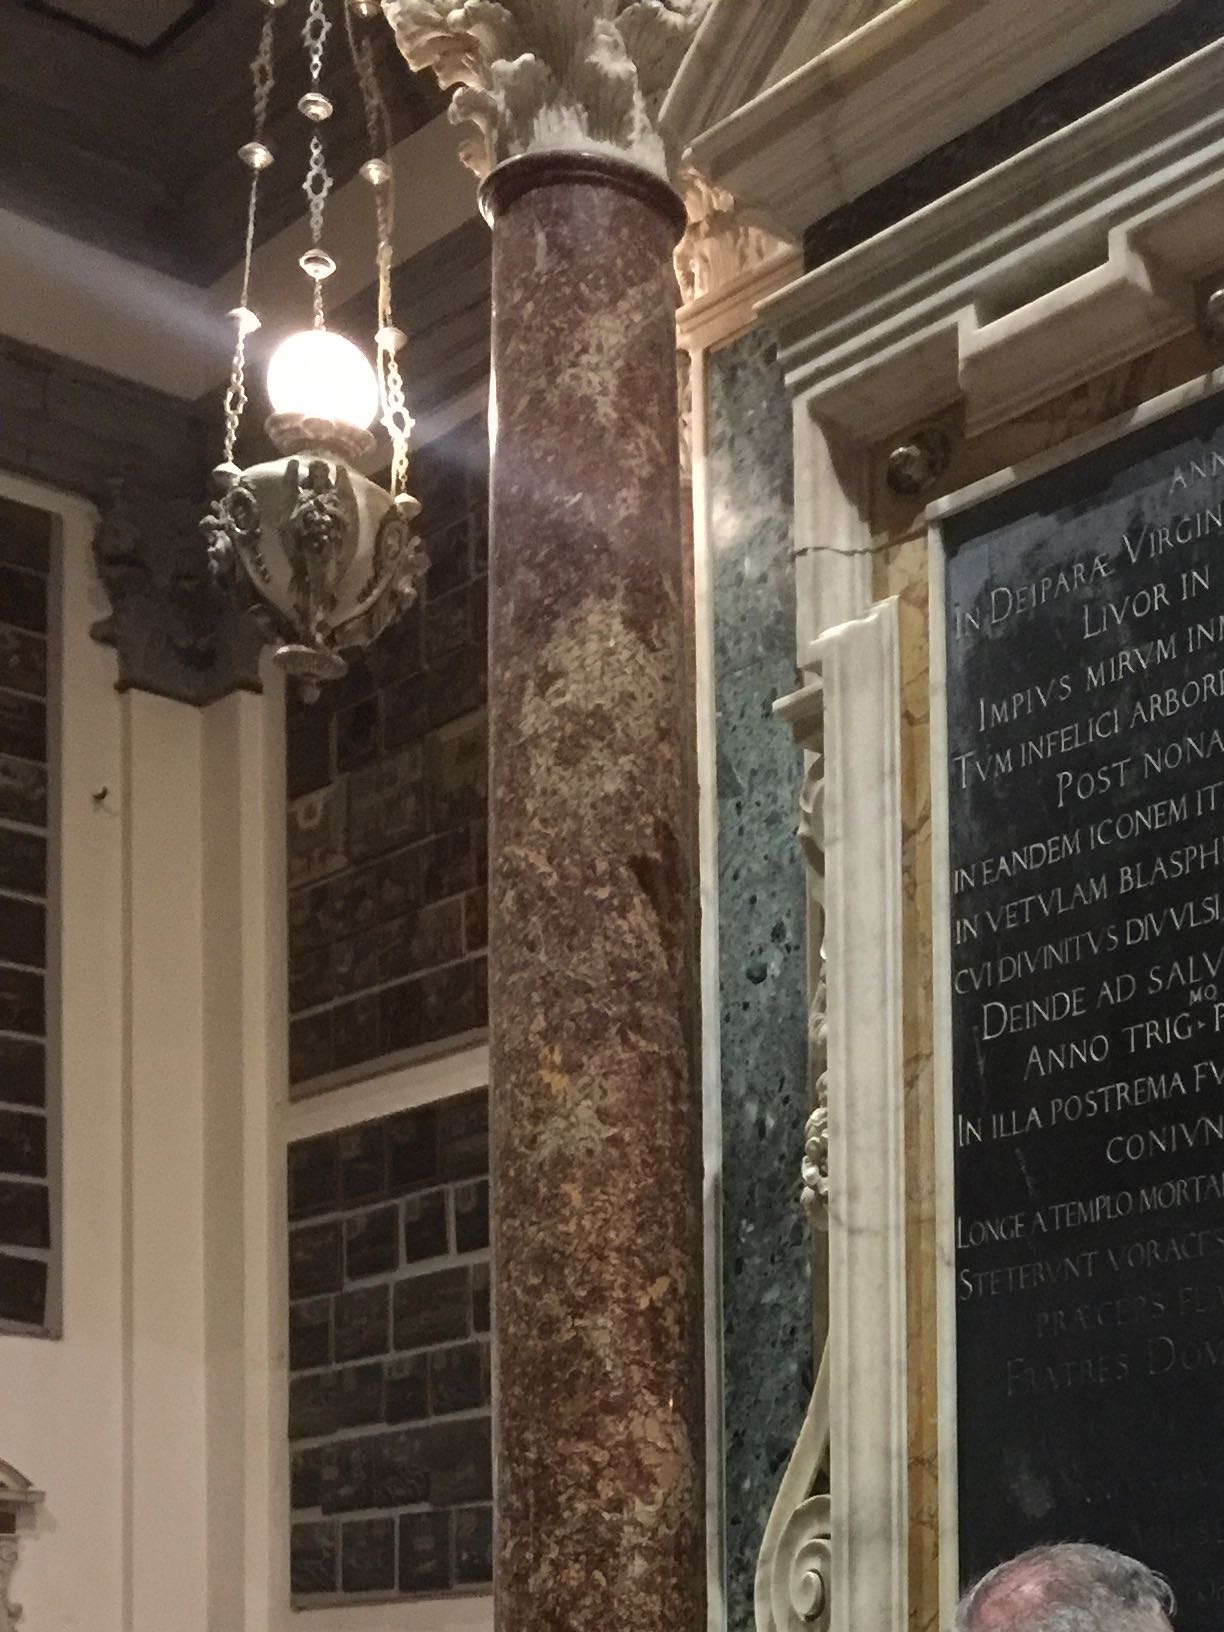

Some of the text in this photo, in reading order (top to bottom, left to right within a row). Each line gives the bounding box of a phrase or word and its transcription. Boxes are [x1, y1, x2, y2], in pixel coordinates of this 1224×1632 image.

[954, 604, 980, 640] IN
[1082, 582, 1171, 640] LIVOR
[1181, 564, 1210, 600] IN
[978, 674, 1072, 732] IMPIVS
[1086, 633, 1177, 692] MIRVM
[953, 748, 1014, 790] TVM
[1020, 708, 1120, 768] INFELICI
[1056, 757, 1132, 808] POST
[953, 863, 976, 894] IN
[982, 828, 1081, 887] EANDEM
[1089, 793, 1189, 850] ICONEM
[955, 918, 978, 945] IN
[985, 873, 1108, 933] VETVLAM
[954, 961, 993, 995] CVI
[999, 924, 1119, 985] DIVINITVS
[982, 987, 1087, 1041] DEINDE
[1097, 973, 1137, 1010] AD
[1023, 1034, 1109, 1081] ANNO
[957, 1113, 983, 1147] IN
[992, 1106, 1043, 1139] ILLA
[1050, 1071, 1188, 1126] POSTREMA
[956, 1211, 1025, 1250] LONGE
[1030, 1211, 1049, 1234] A
[1048, 1191, 1134, 1231] TEMPLO
